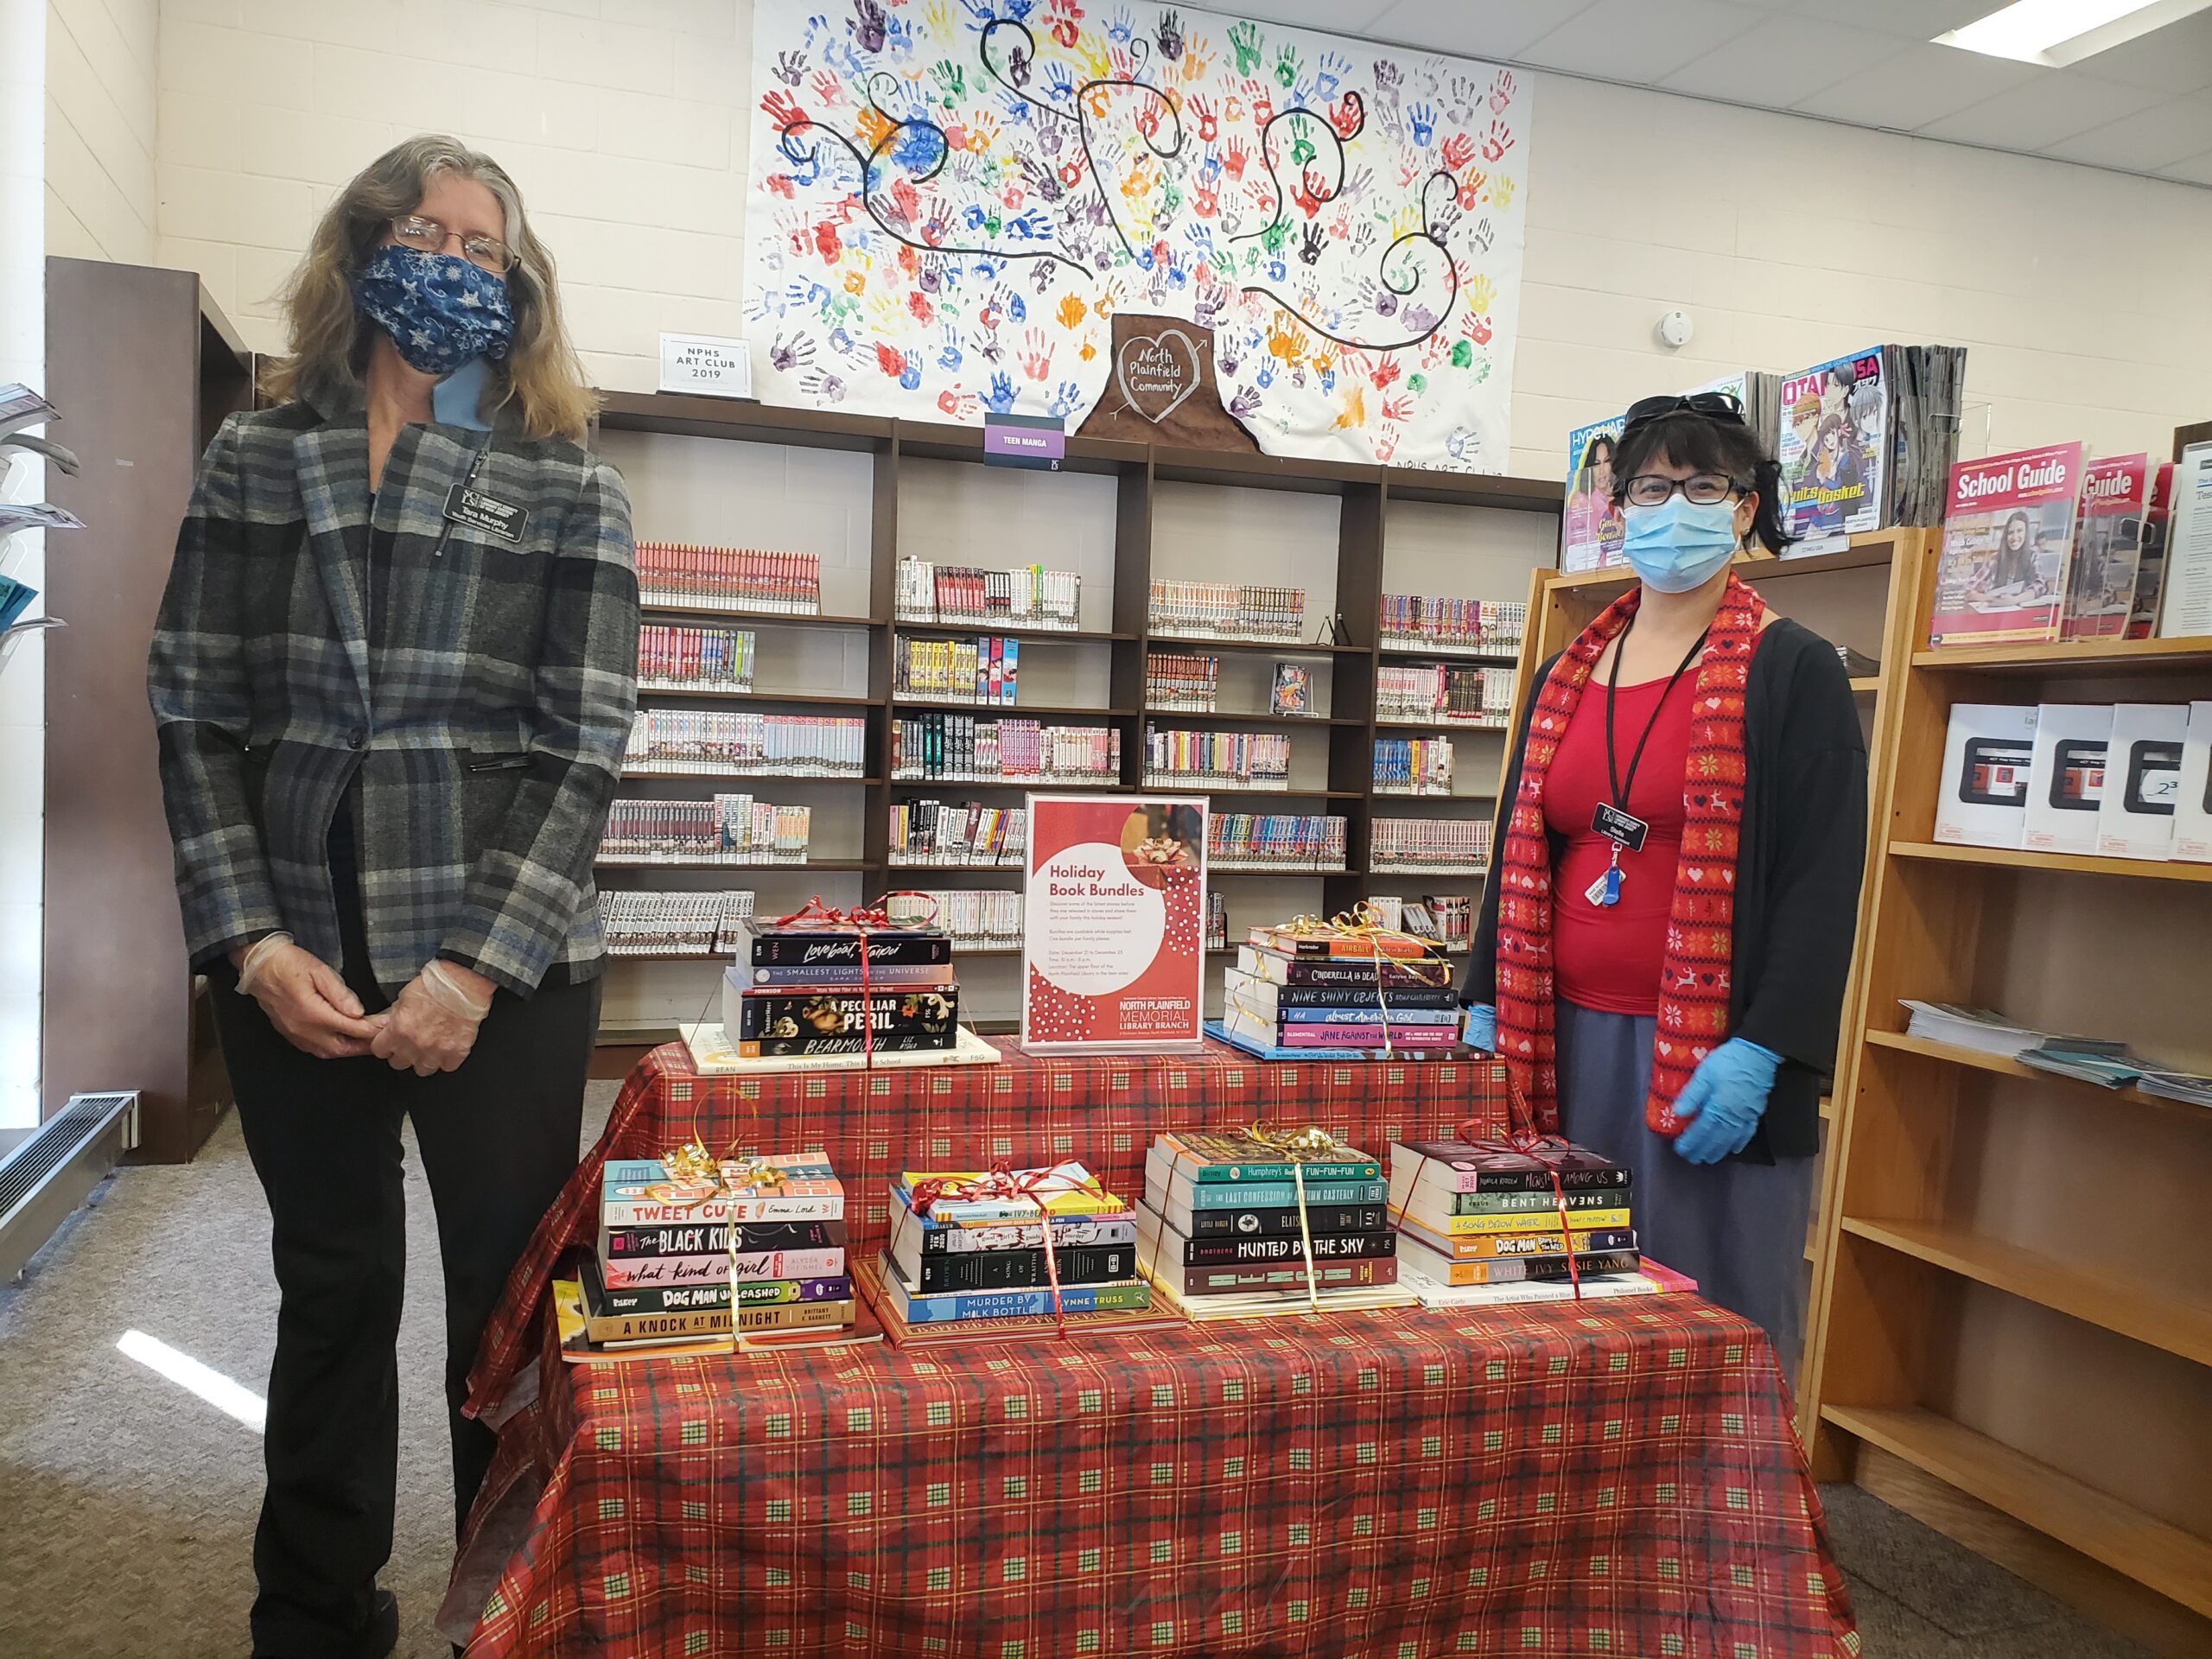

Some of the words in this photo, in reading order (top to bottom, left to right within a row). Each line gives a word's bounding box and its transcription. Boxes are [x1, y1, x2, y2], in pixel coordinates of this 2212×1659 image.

[688, 348, 720, 358] NPHS
[1138, 347, 1173, 364] North
[677, 356, 700, 365] ART
[705, 359, 735, 368] CLUB
[692, 369, 721, 378] 2019
[1129, 361, 1181, 378] Plainfield
[1130, 376, 1183, 400] Community
[1003, 436, 1020, 445] TEEN
[1022, 438, 1046, 448] MANGA
[1957, 467, 2013, 499] School
[2018, 459, 2066, 490] Guide
[2082, 470, 2132, 499] Guide
[1819, 483, 1865, 505] basket
[462, 505, 479, 518] Tara
[480, 512, 510, 530] Murphy
[452, 511, 467, 521] Youth
[467, 518, 491, 530] Services
[491, 526, 514, 538] Librarian
[1050, 865, 1105, 881] Holiday
[1050, 883, 1085, 896] Book
[1090, 883, 1144, 896] Bundles
[859, 942, 901, 959] Taipei
[834, 968, 863, 976] LIGHTS
[1312, 969, 1353, 982] CINDERELLA
[1354, 971, 1361, 980] IS
[1362, 971, 1380, 981] DEAD
[1292, 991, 1316, 1002] NINE
[1320, 991, 1351, 1002] SHINY
[1354, 991, 1393, 1003] OBJECTS
[830, 1002, 837, 1013] A
[841, 1000, 897, 1013] PECULIAR
[1120, 1001, 1146, 1011] NORTH
[1147, 1001, 1191, 1010] PLAINFIELD
[843, 1013, 894, 1031] PERIL
[1120, 1010, 1189, 1022] MEMORIAL
[1325, 1012, 1354, 1022] almost
[1396, 1012, 1417, 1022] Girl
[1320, 1031, 1339, 1040] JANE
[1341, 1031, 1370, 1040] AGAINST
[804, 1038, 887, 1055] BEARMOUTH
[810, 1062, 821, 1071] My
[823, 1061, 843, 1071] Home,
[844, 1060, 861, 1069] This
[880, 1058, 900, 1067] School
[1248, 1166, 1282, 1178] Humphrey's
[1564, 1172, 1592, 1184] AMONG
[1596, 1171, 1608, 1184] US
[1479, 1177, 1498, 1185] MONICA
[1500, 1176, 1518, 1185] RODDEN
[1225, 1192, 1243, 1204] LAST
[1243, 1190, 1285, 1203] CONFESSION
[1323, 1188, 1355, 1200] CASTERLY
[795, 1205, 817, 1214] Lord
[1502, 1198, 1535, 1208] BENT
[632, 1205, 693, 1221] TWEET
[1014, 1210, 1027, 1218] IVY
[1215, 1219, 1228, 1228] BADGER
[1462, 1220, 1485, 1230] SONG
[1488, 1218, 1512, 1229] BELOW
[1516, 1217, 1541, 1227] WATER
[640, 1233, 660, 1249] The
[659, 1230, 702, 1253] BLACK
[709, 1226, 743, 1251] KIDS
[1000, 1233, 1014, 1242] girl's
[1238, 1241, 1287, 1258] HUNTED
[1293, 1240, 1308, 1255] BY
[1313, 1239, 1336, 1254] THE
[1340, 1238, 1365, 1254] SKY
[1496, 1239, 1516, 1254] DOG
[1517, 1238, 1536, 1252] MAN
[626, 1259, 666, 1282] what
[671, 1258, 710, 1278] kind
[735, 1255, 770, 1281] girl
[1019, 1264, 1024, 1273] OF
[1493, 1264, 1528, 1276] WHITE
[1535, 1263, 1553, 1274] IVY
[1598, 1258, 1629, 1270] YANG
[1209, 1268, 1351, 1287] HENCH
[663, 1289, 690, 1306] DOG
[692, 1289, 717, 1306] MAN
[967, 1296, 1014, 1307] MURDER
[1017, 1295, 1032, 1304] BY
[1093, 1295, 1123, 1305] TRUSS
[962, 1309, 988, 1319] MILK
[994, 1306, 1035, 1316] BOTTLE
[623, 1321, 632, 1334] A
[639, 1318, 687, 1333] KNOCK
[694, 1316, 706, 1325] AT
[710, 1311, 781, 1328] MIDNIGHT
[917, 1322, 982, 1333] BAFFLED
[987, 1319, 1014, 1329] ALL
